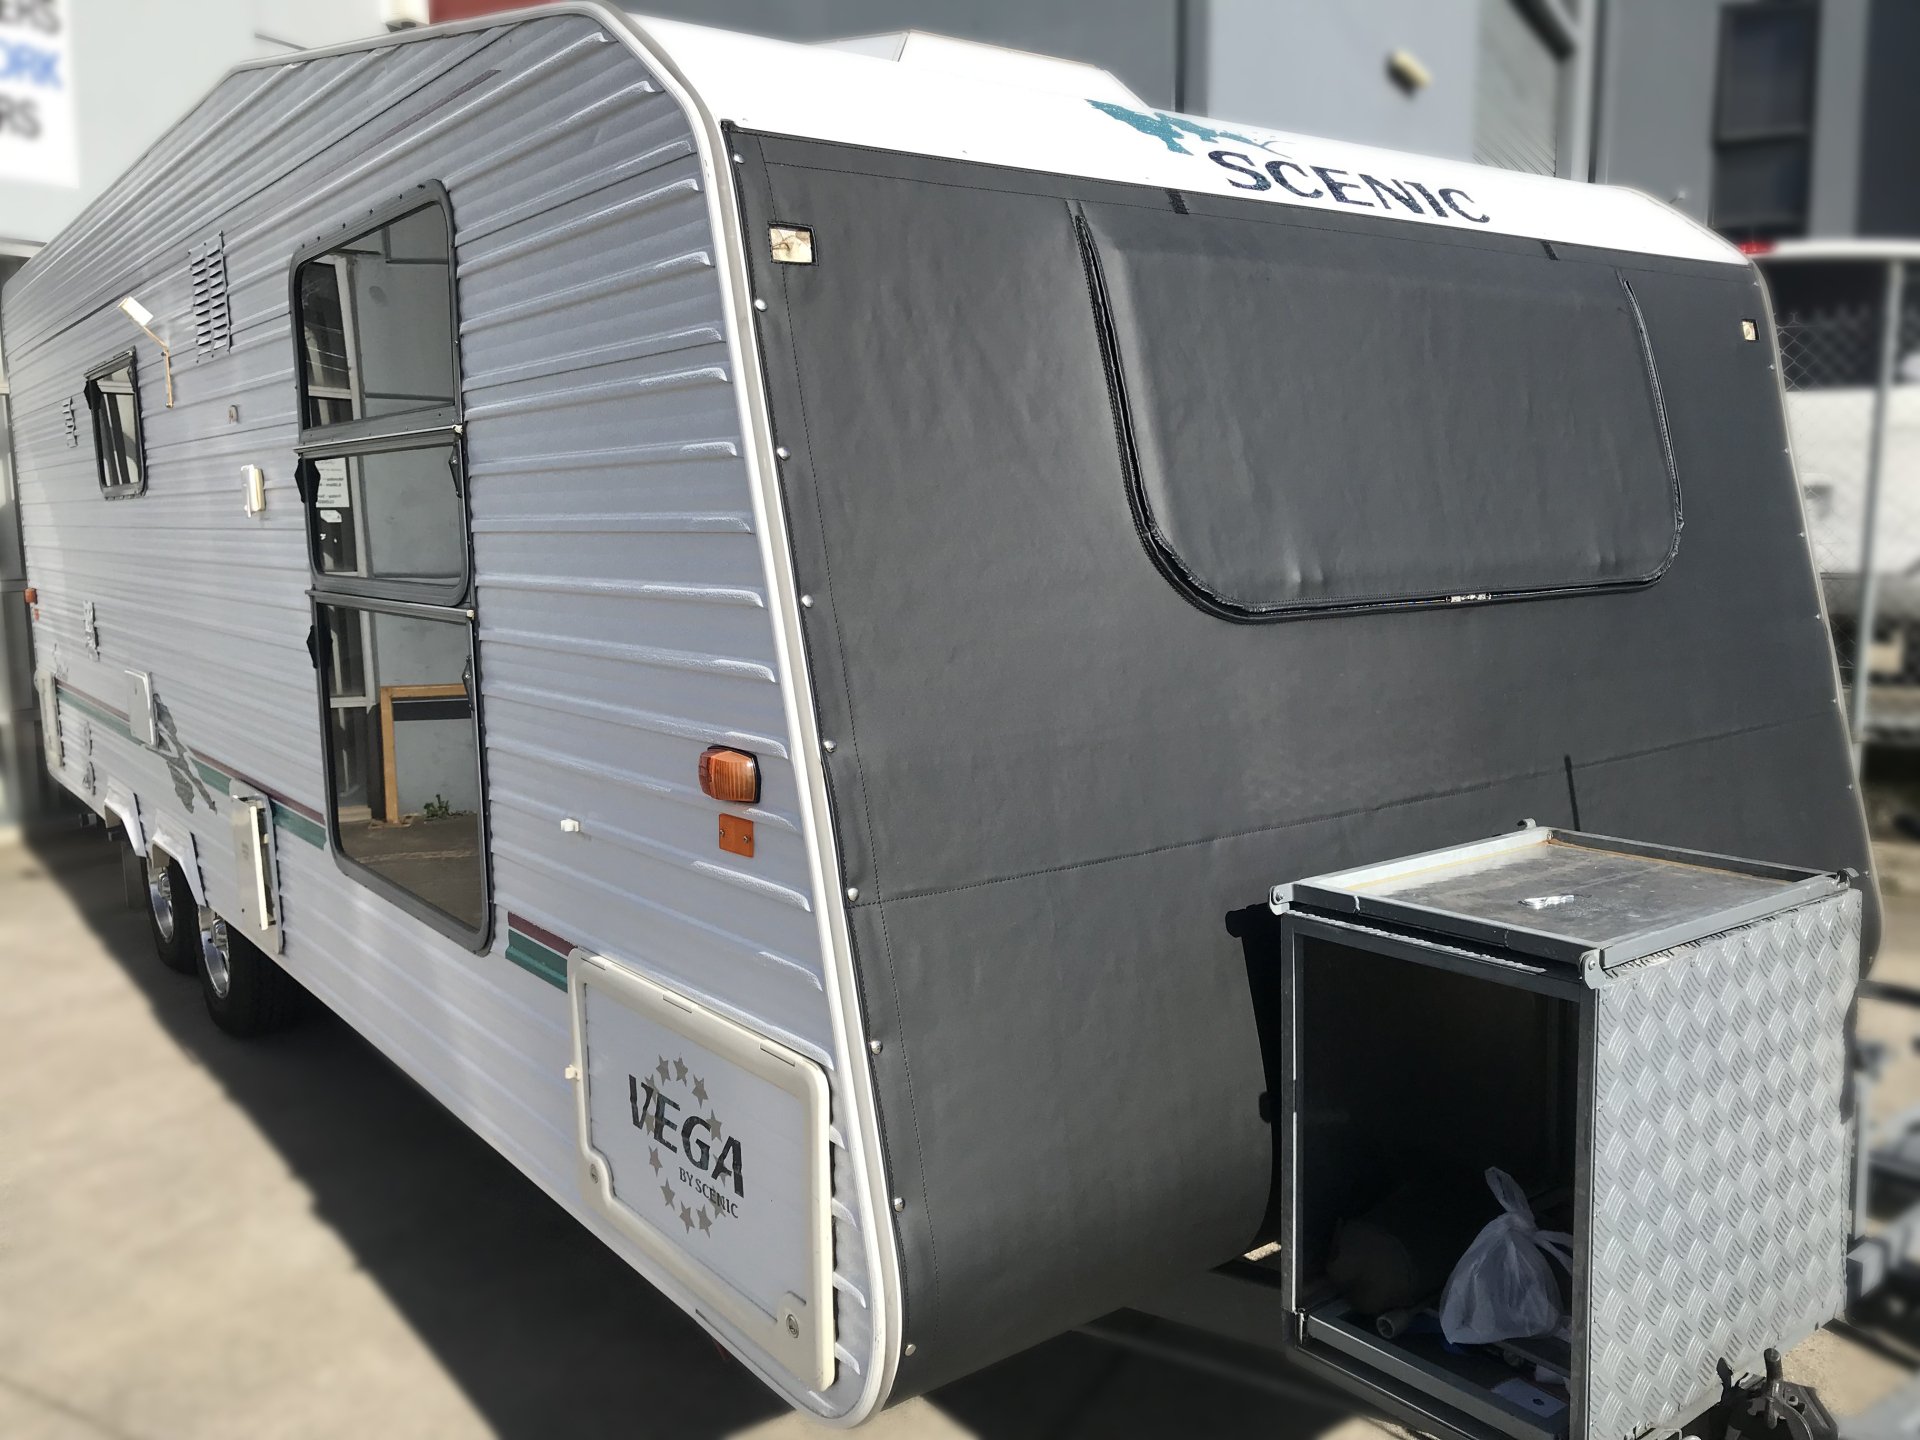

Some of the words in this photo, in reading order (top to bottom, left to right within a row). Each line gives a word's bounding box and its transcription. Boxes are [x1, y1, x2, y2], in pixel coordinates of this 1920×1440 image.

[1208, 150, 1490, 222] SCENIC
[628, 1074, 744, 1198] VEGA
[679, 1166, 694, 1187] BY
[695, 1178, 738, 1218] SCENIC
